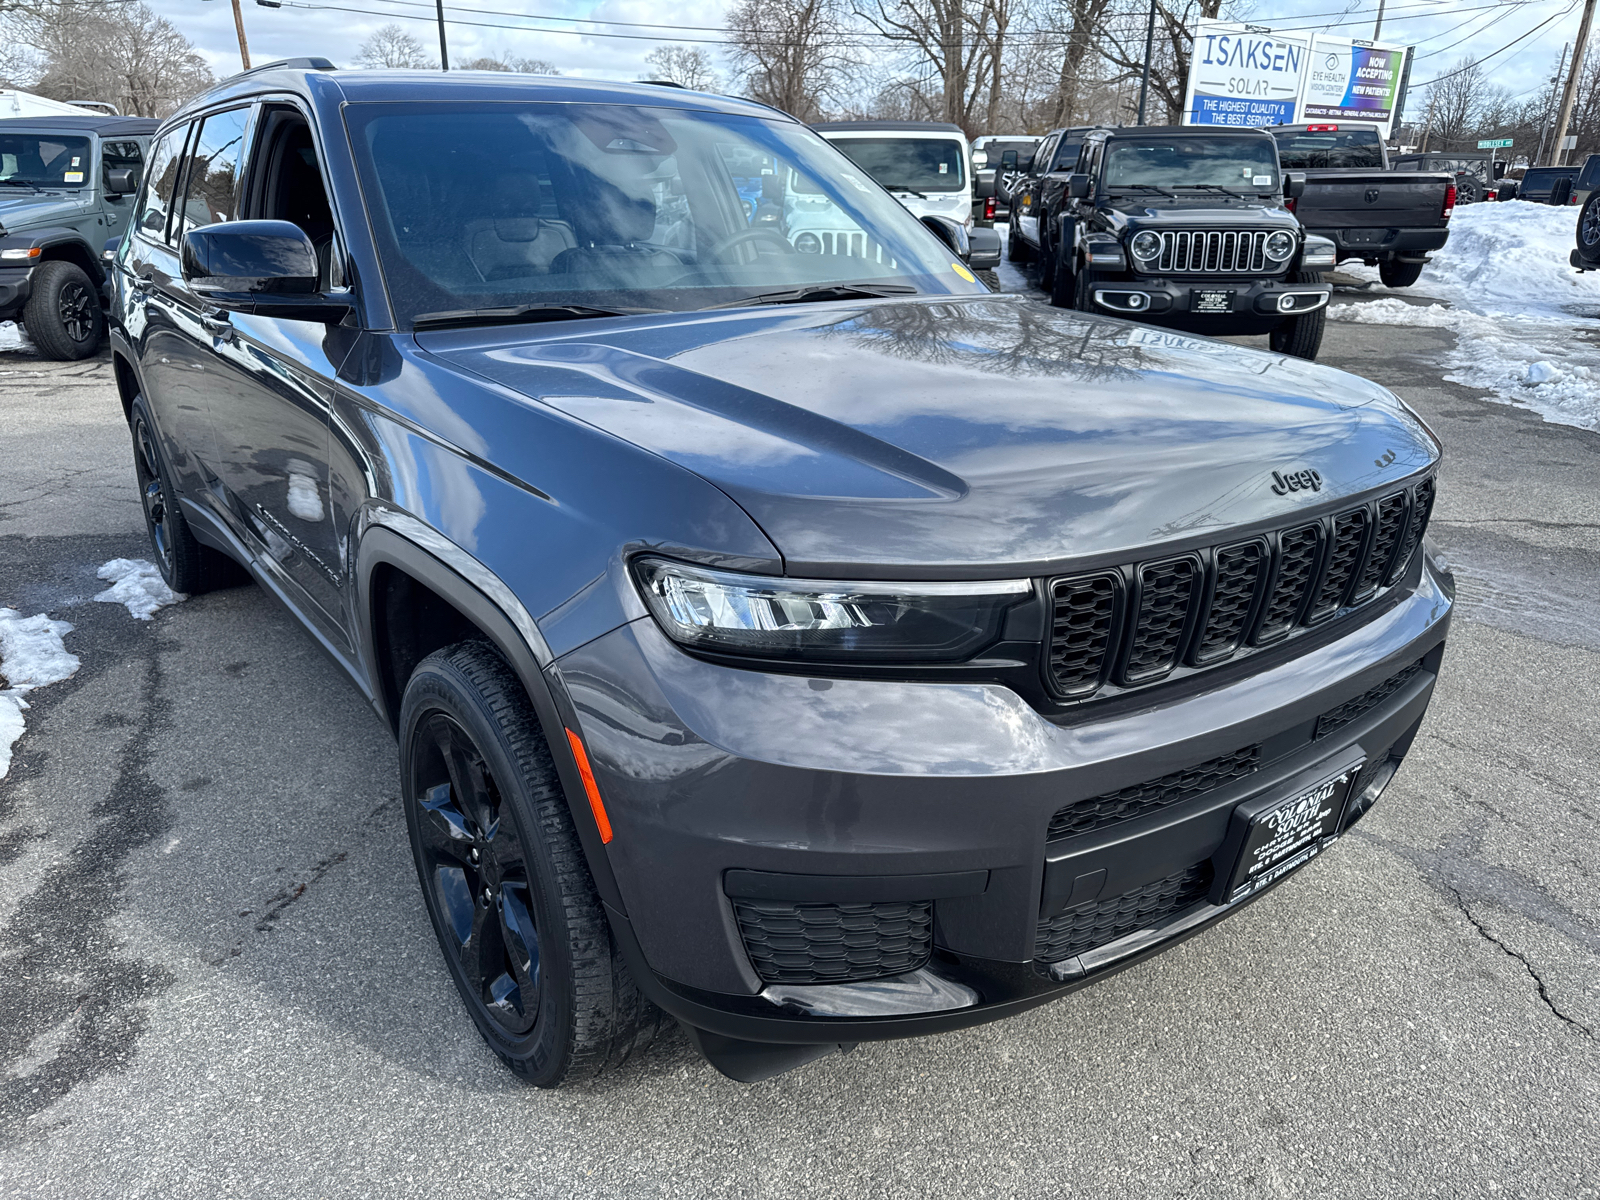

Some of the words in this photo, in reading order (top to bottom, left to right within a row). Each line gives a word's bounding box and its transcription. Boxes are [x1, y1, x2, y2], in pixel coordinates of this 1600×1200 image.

[1202, 34, 1301, 73] ISAKSEN
[1368, 56, 1385, 68] NOW
[1312, 71, 1323, 81] EYE
[1324, 72, 1346, 83] HEALTH
[1356, 67, 1393, 81] ACCEPTING
[1228, 77, 1269, 96] SOLAR
[1310, 83, 1325, 91] VISION
[1352, 85, 1365, 95] NEW
[1203, 99, 1218, 111] THE
[1218, 100, 1250, 113] HIGHEST
[1250, 102, 1279, 115] QUALITY
[1280, 105, 1285, 115] &
[1211, 112, 1226, 124] THE
[1226, 113, 1245, 125] BEST
[1246, 115, 1275, 126] SERVICE
[1270, 468, 1323, 496] Jeep
[1268, 783, 1335, 829] COLONIAL
[1274, 802, 1321, 838] SOUTH
[1253, 821, 1310, 855] CHRYSLER
[1257, 836, 1295, 861] DODGE
[1264, 857, 1271, 865] 6
